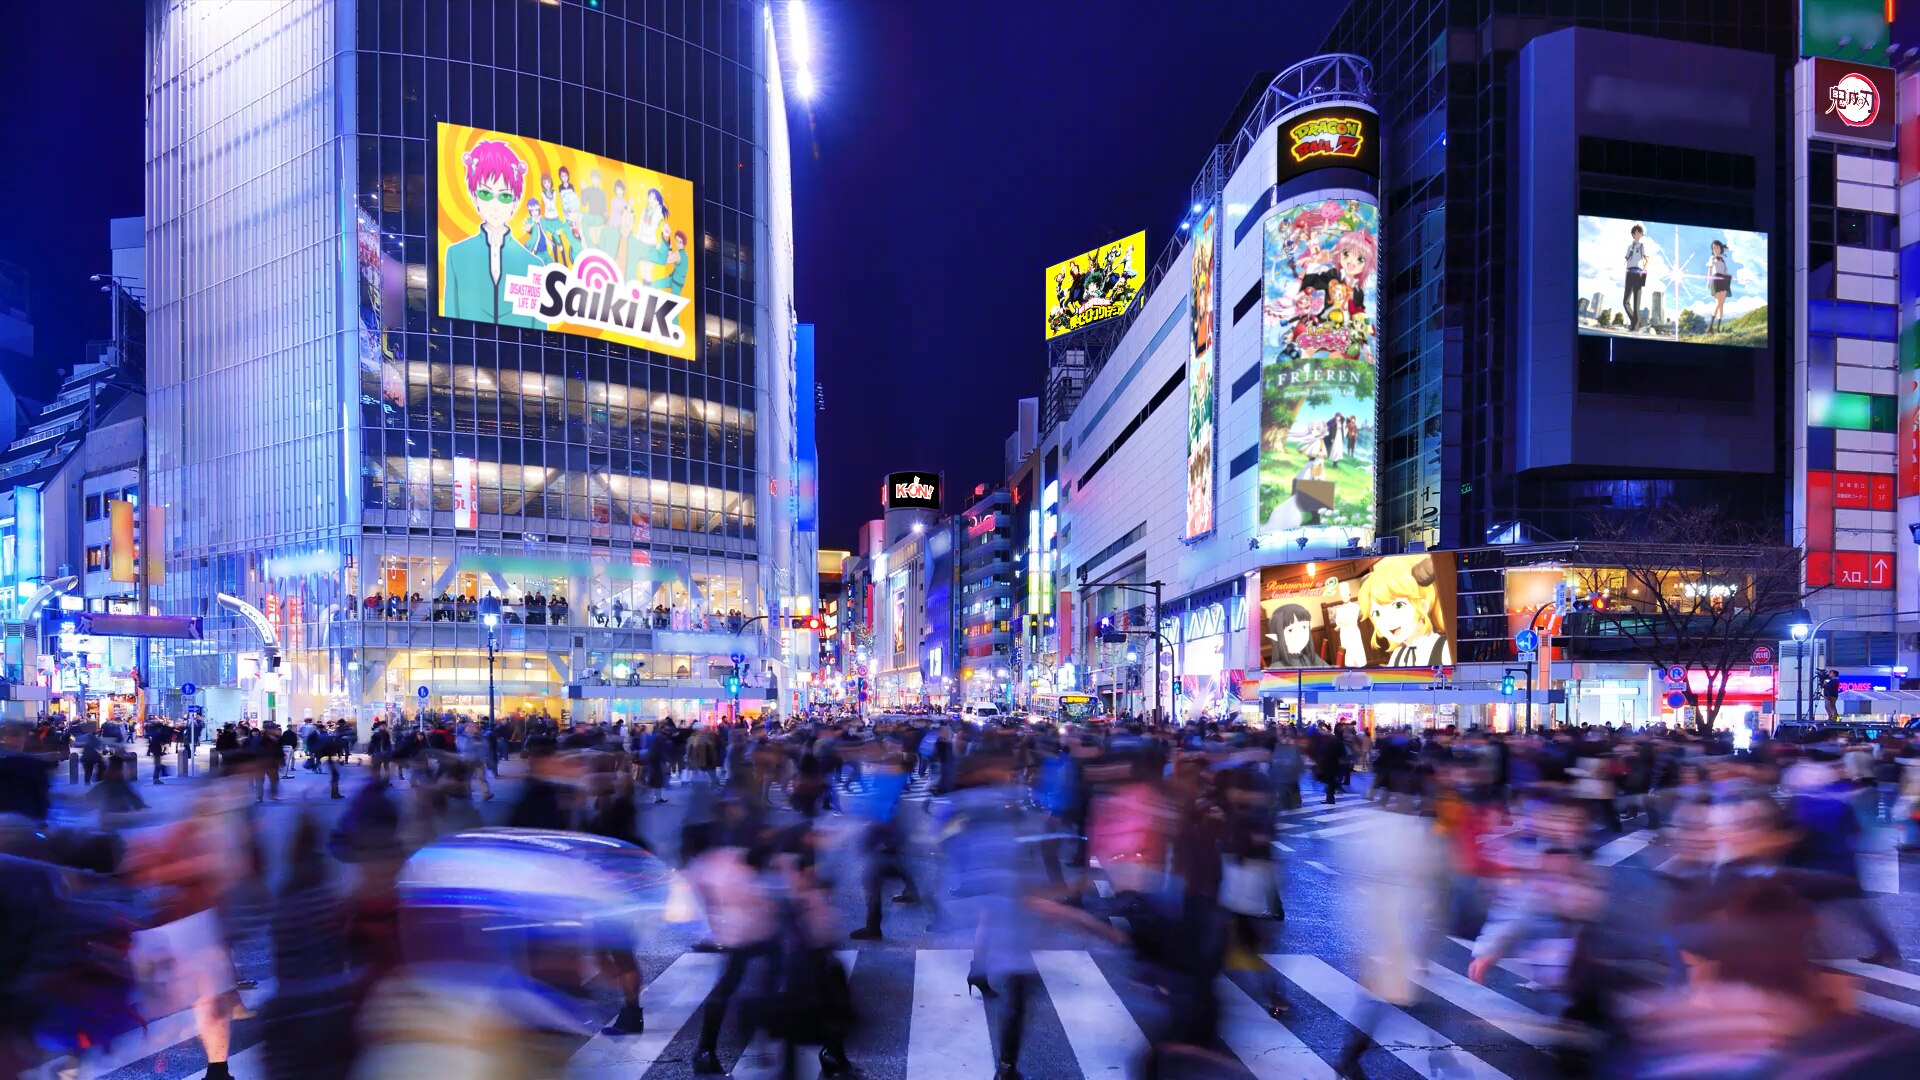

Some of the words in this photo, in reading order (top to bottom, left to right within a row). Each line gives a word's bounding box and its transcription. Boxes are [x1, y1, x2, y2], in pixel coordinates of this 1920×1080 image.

[1295, 120, 1358, 138] DRAGON
[1295, 139, 1334, 158] BALL
[1336, 136, 1361, 154] Z
[532, 273, 542, 286] THE
[509, 282, 541, 298] DISASTROUS
[518, 297, 530, 309] LIFE
[530, 298, 537, 310] OF
[539, 270, 640, 329] Saiki
[1277, 367, 1360, 386] FRIEREN
[896, 479, 934, 500] K-ON!
[1841, 570, 1861, 583] 入口
[1266, 580, 1314, 591] Restaurant
[1266, 590, 1297, 599] Another
[1324, 576, 1338, 597] 2
[1838, 682, 1872, 691] PROMISE
